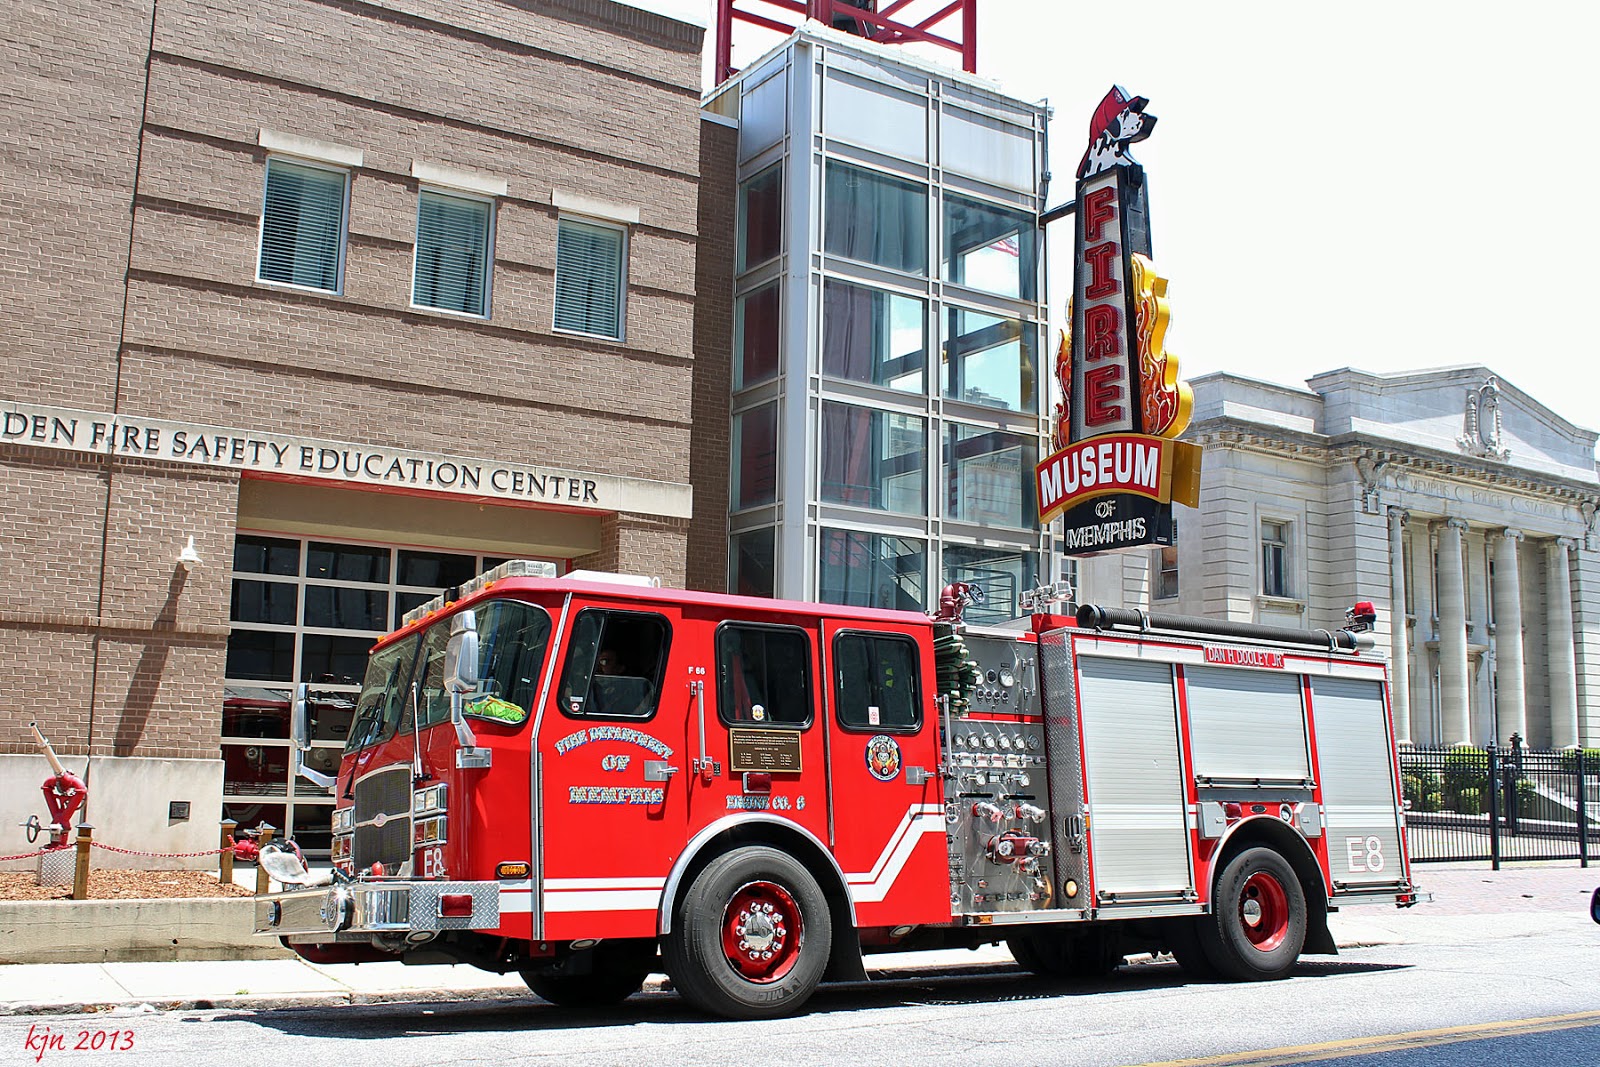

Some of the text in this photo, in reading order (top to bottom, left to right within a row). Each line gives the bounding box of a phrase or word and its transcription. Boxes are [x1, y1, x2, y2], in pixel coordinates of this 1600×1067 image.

[1084, 185, 1125, 428] FIRE
[90, 421, 161, 455] FIRE
[171, 431, 290, 468] SAFETY
[299, 445, 481, 489] EDUCATION
[491, 469, 599, 503] CENTER
[1040, 442, 1159, 508] MUSEUM
[1094, 499, 1117, 519] OF
[1066, 517, 1147, 549] MEMPHIS
[1208, 646, 1226, 663] DAN
[688, 666, 694, 675] F
[554, 725, 675, 761] FIRE DEPARTMENT
[601, 754, 631, 772] OF
[568, 785, 665, 805] MEMPHIS
[725, 794, 771, 810] ENGINE
[424, 847, 446, 877] E8
[1345, 835, 1385, 874] E8
